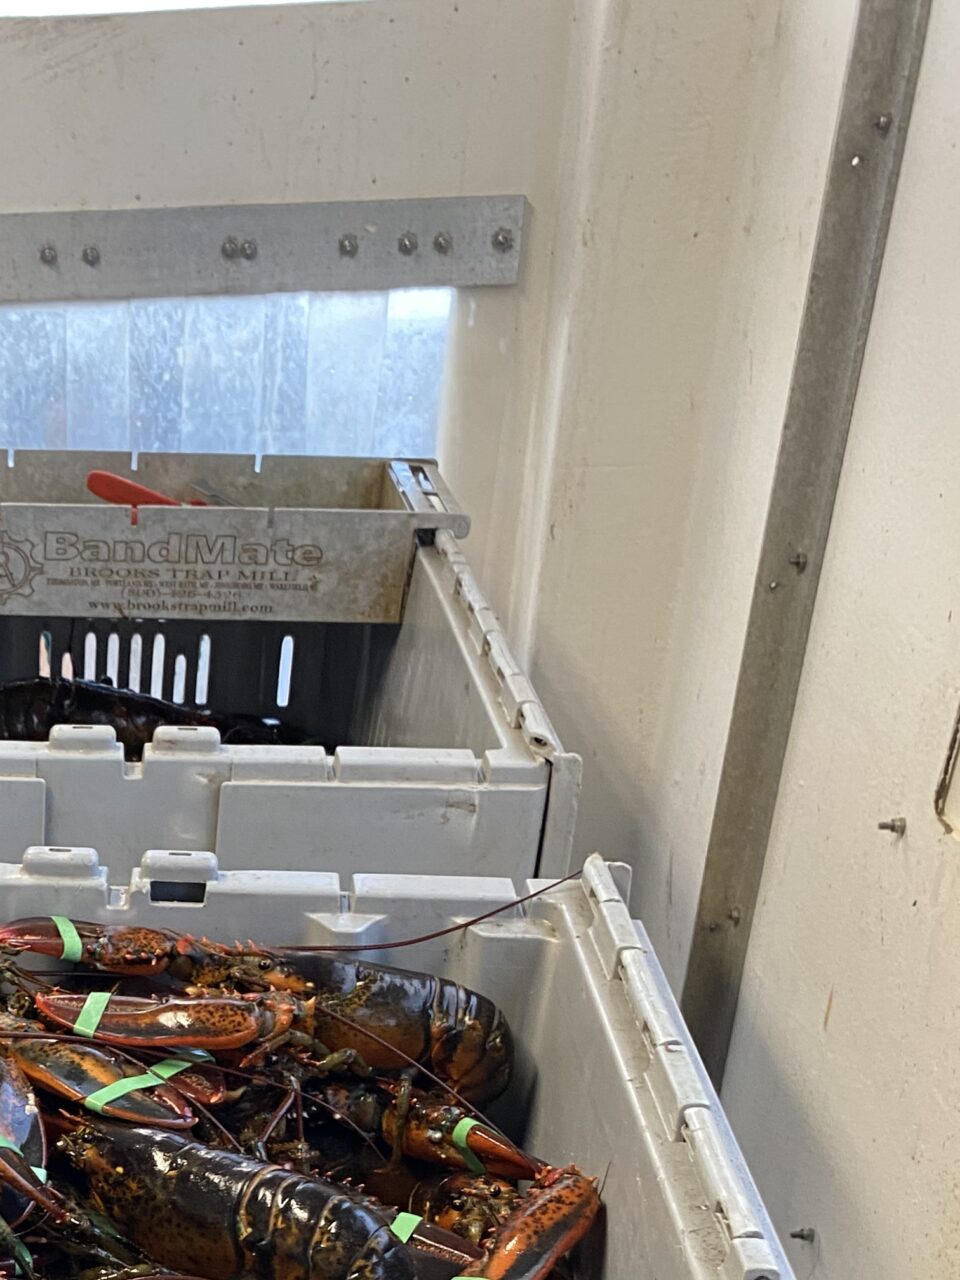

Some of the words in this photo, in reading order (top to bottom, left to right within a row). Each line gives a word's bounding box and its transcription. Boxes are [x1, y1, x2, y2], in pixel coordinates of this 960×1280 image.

[44, 531, 323, 567] BandMate
[69, 567, 160, 578] BROOKS
[166, 568, 231, 580] TRAP
[238, 570, 297, 581] MILL
